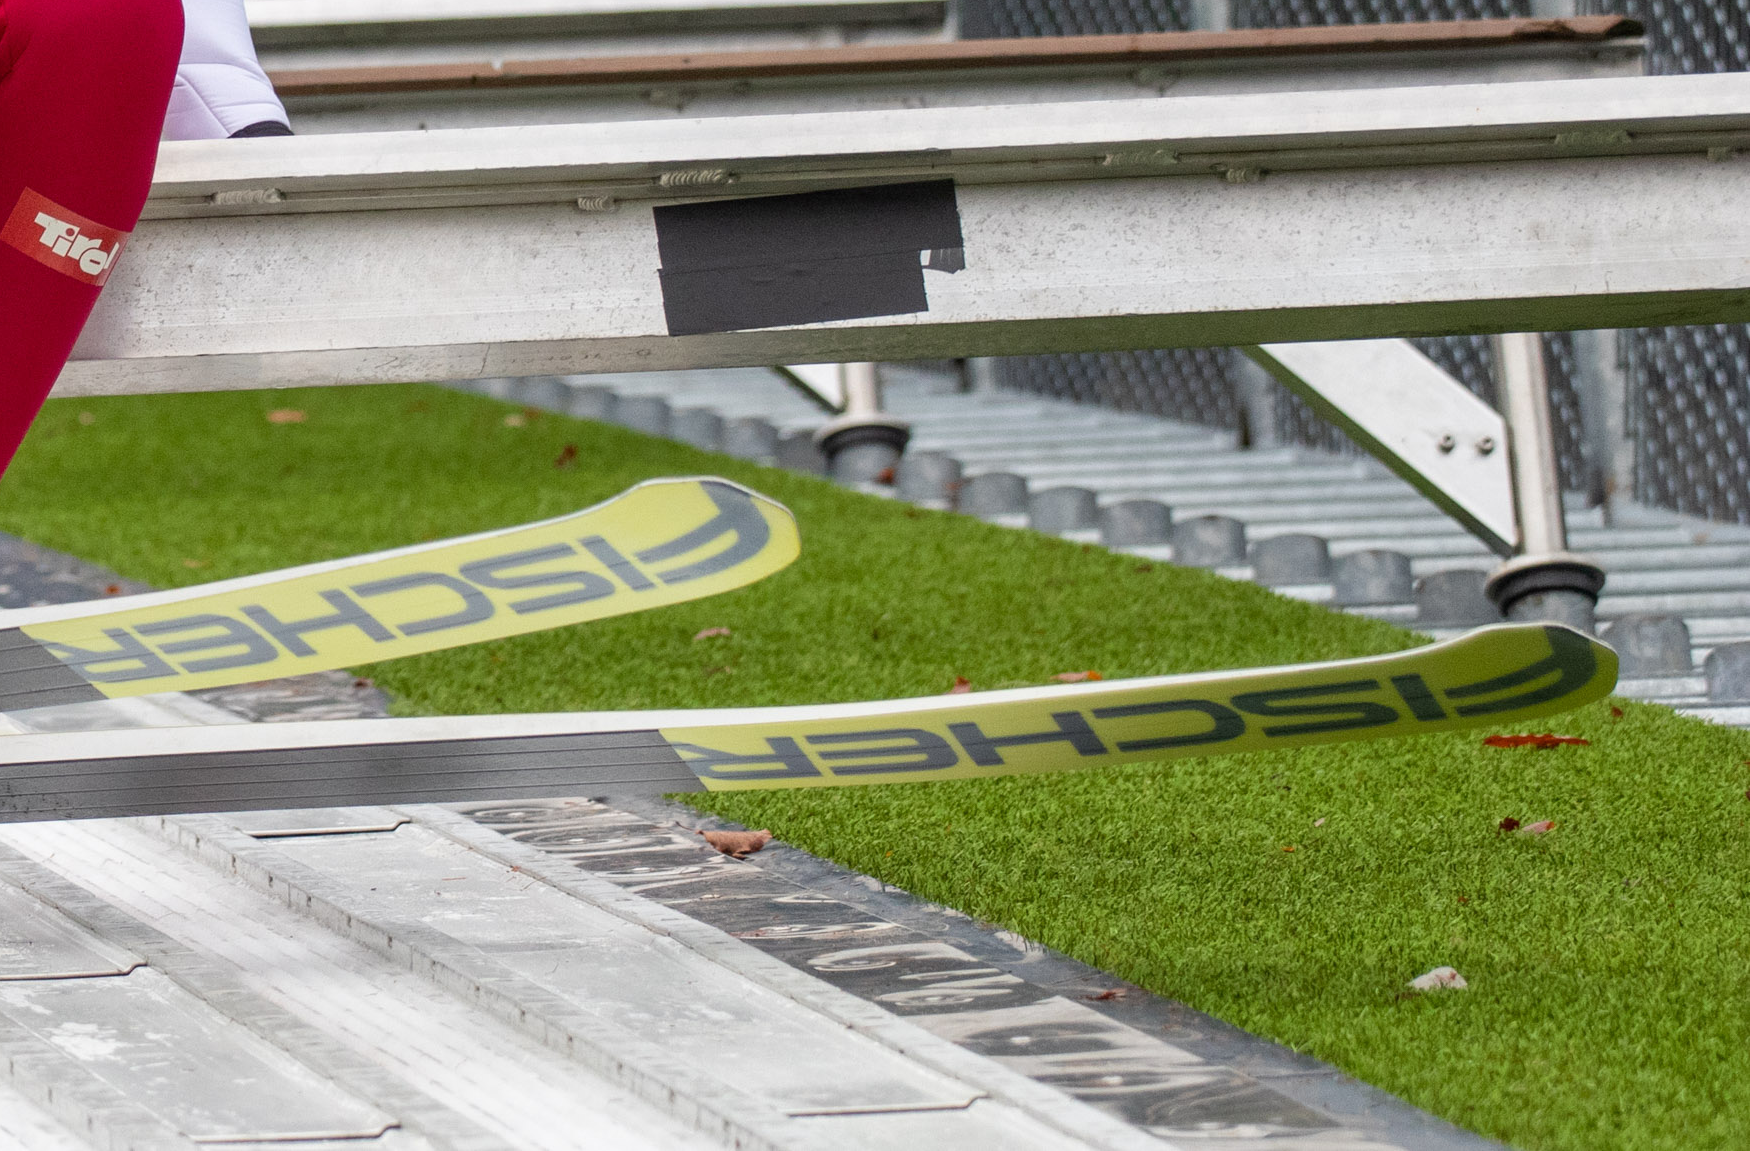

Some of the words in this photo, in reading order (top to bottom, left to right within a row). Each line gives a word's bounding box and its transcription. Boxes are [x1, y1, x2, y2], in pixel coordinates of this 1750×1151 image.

[34, 211, 120, 276] Tirol
[34, 480, 770, 684] FISCHER
[670, 624, 1600, 781] FISCHER
